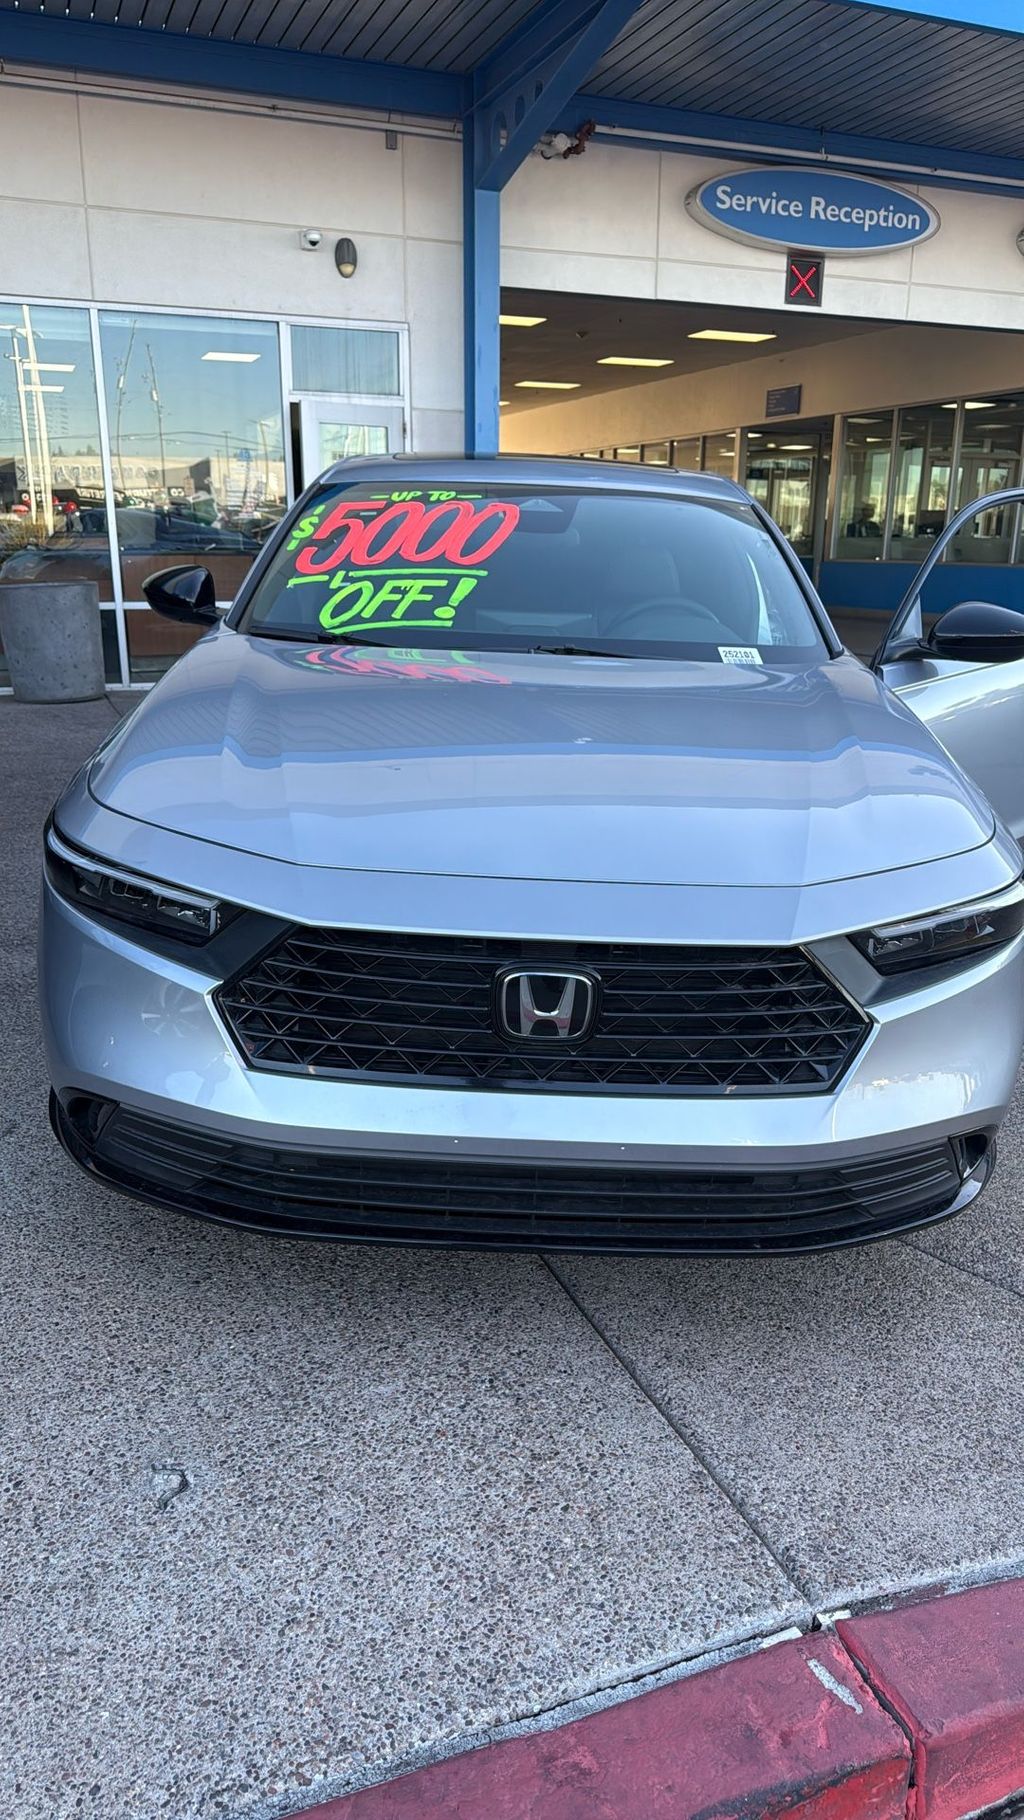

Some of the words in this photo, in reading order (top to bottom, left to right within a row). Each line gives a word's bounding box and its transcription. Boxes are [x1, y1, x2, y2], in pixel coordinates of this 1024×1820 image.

[715, 185, 803, 218] Service
[809, 196, 921, 232] Reception
[390, 491, 422, 501] UP
[428, 491, 457, 501] TO
[319, 577, 477, 629] OFF!
